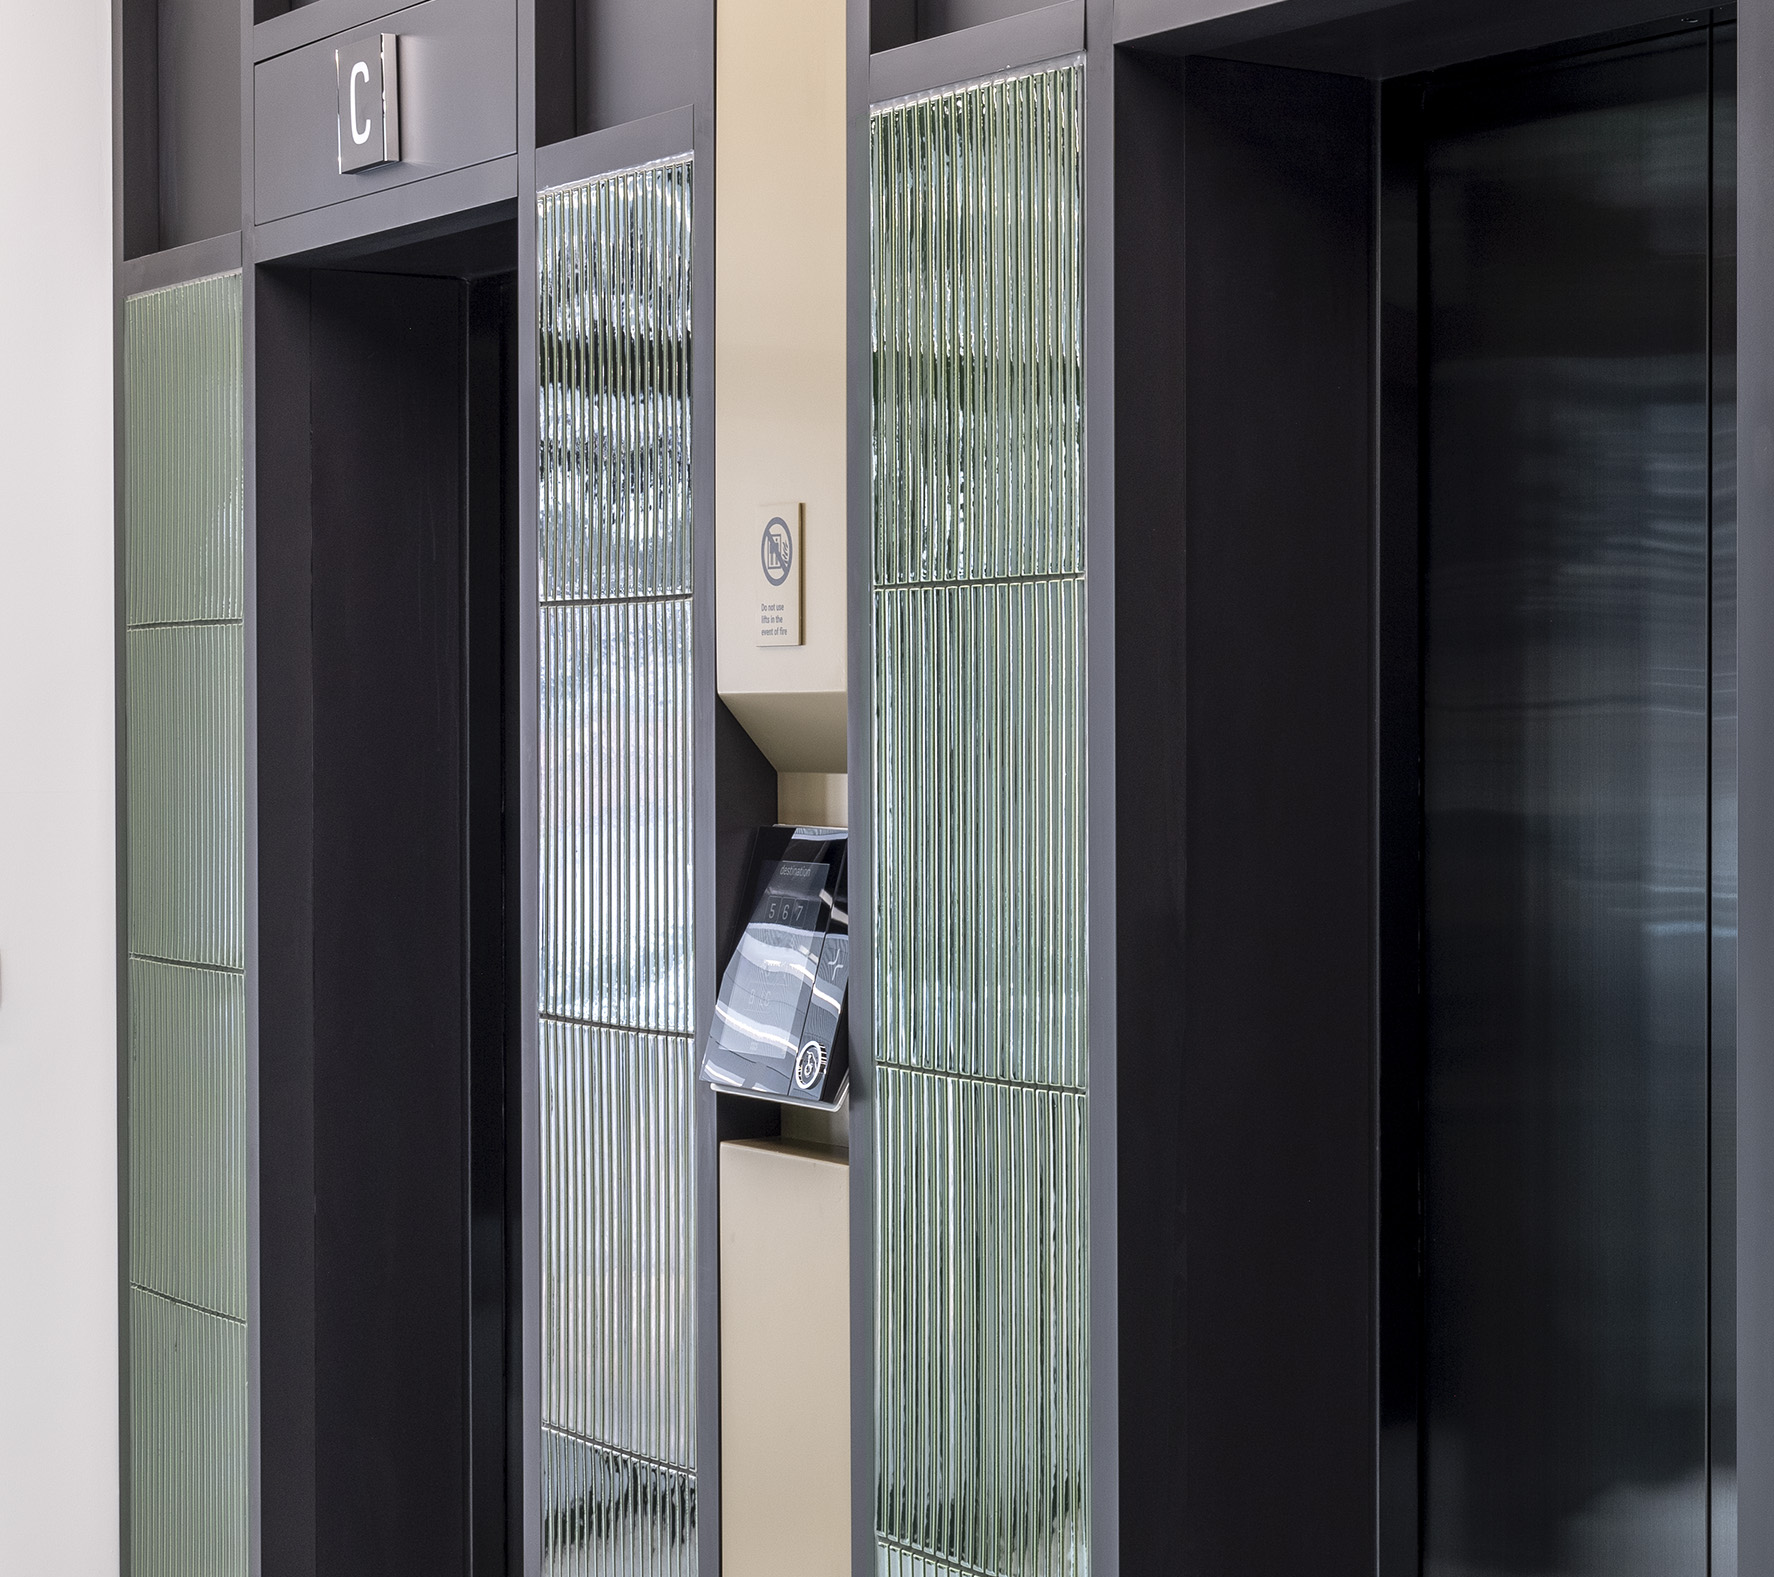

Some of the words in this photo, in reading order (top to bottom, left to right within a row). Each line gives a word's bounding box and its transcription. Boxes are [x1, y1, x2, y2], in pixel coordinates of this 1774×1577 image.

[350, 61, 371, 145] C
[761, 615, 770, 623] lifts
[771, 615, 775, 623] in
[775, 615, 783, 623] the
[761, 628, 773, 636] event
[774, 627, 779, 636] of
[779, 627, 787, 635] fire
[780, 865, 811, 878] destination
[769, 903, 776, 919] 5
[782, 904, 789, 920] 6
[796, 906, 803, 921] 7
